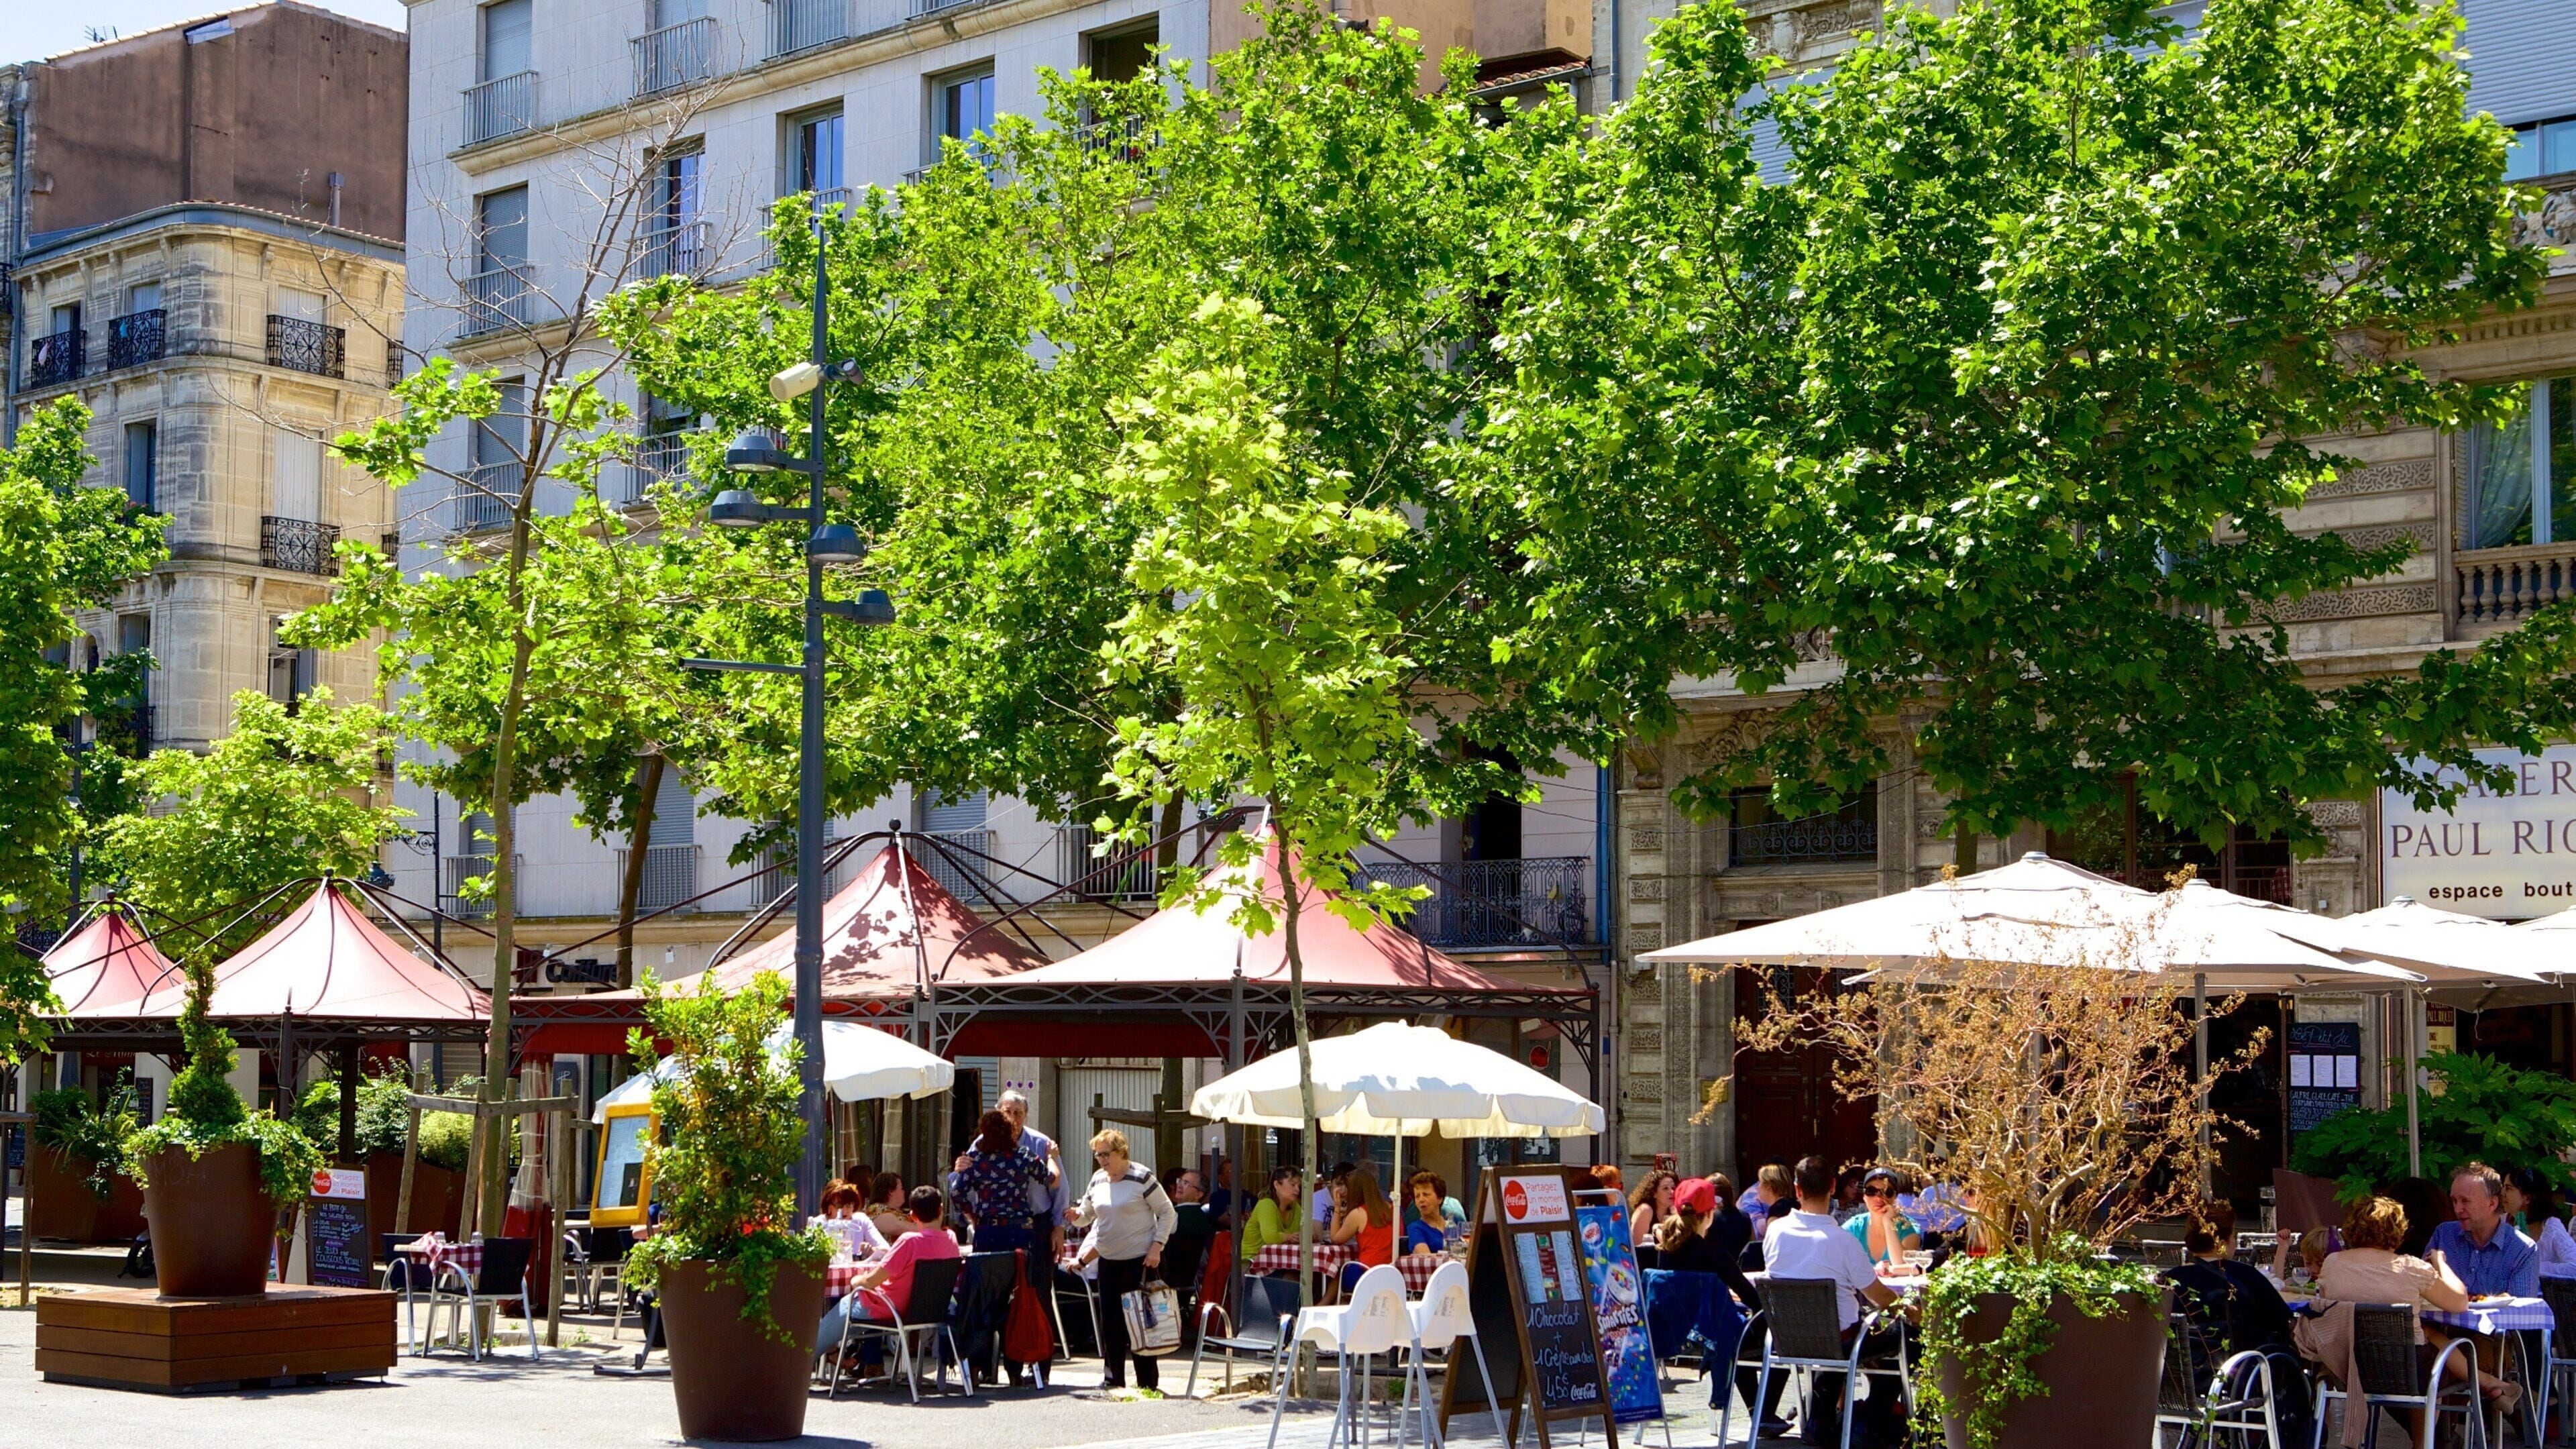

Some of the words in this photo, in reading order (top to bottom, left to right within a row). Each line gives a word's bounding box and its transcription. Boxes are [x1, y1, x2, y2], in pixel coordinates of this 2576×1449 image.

[2432, 761, 2576, 798] GAER
[2391, 822, 2492, 858] PAUL
[2429, 883, 2503, 902] espace
[2524, 881, 2572, 897] bout
[1525, 1183, 1558, 1193] Partagez
[1505, 1193, 1527, 1206] Coca-Cola
[1538, 1195, 1564, 1203] moment
[1530, 1208, 1539, 1216] de
[1540, 1205, 1562, 1215] Plaisir
[1570, 1382, 1597, 1401] Coca-Cola
